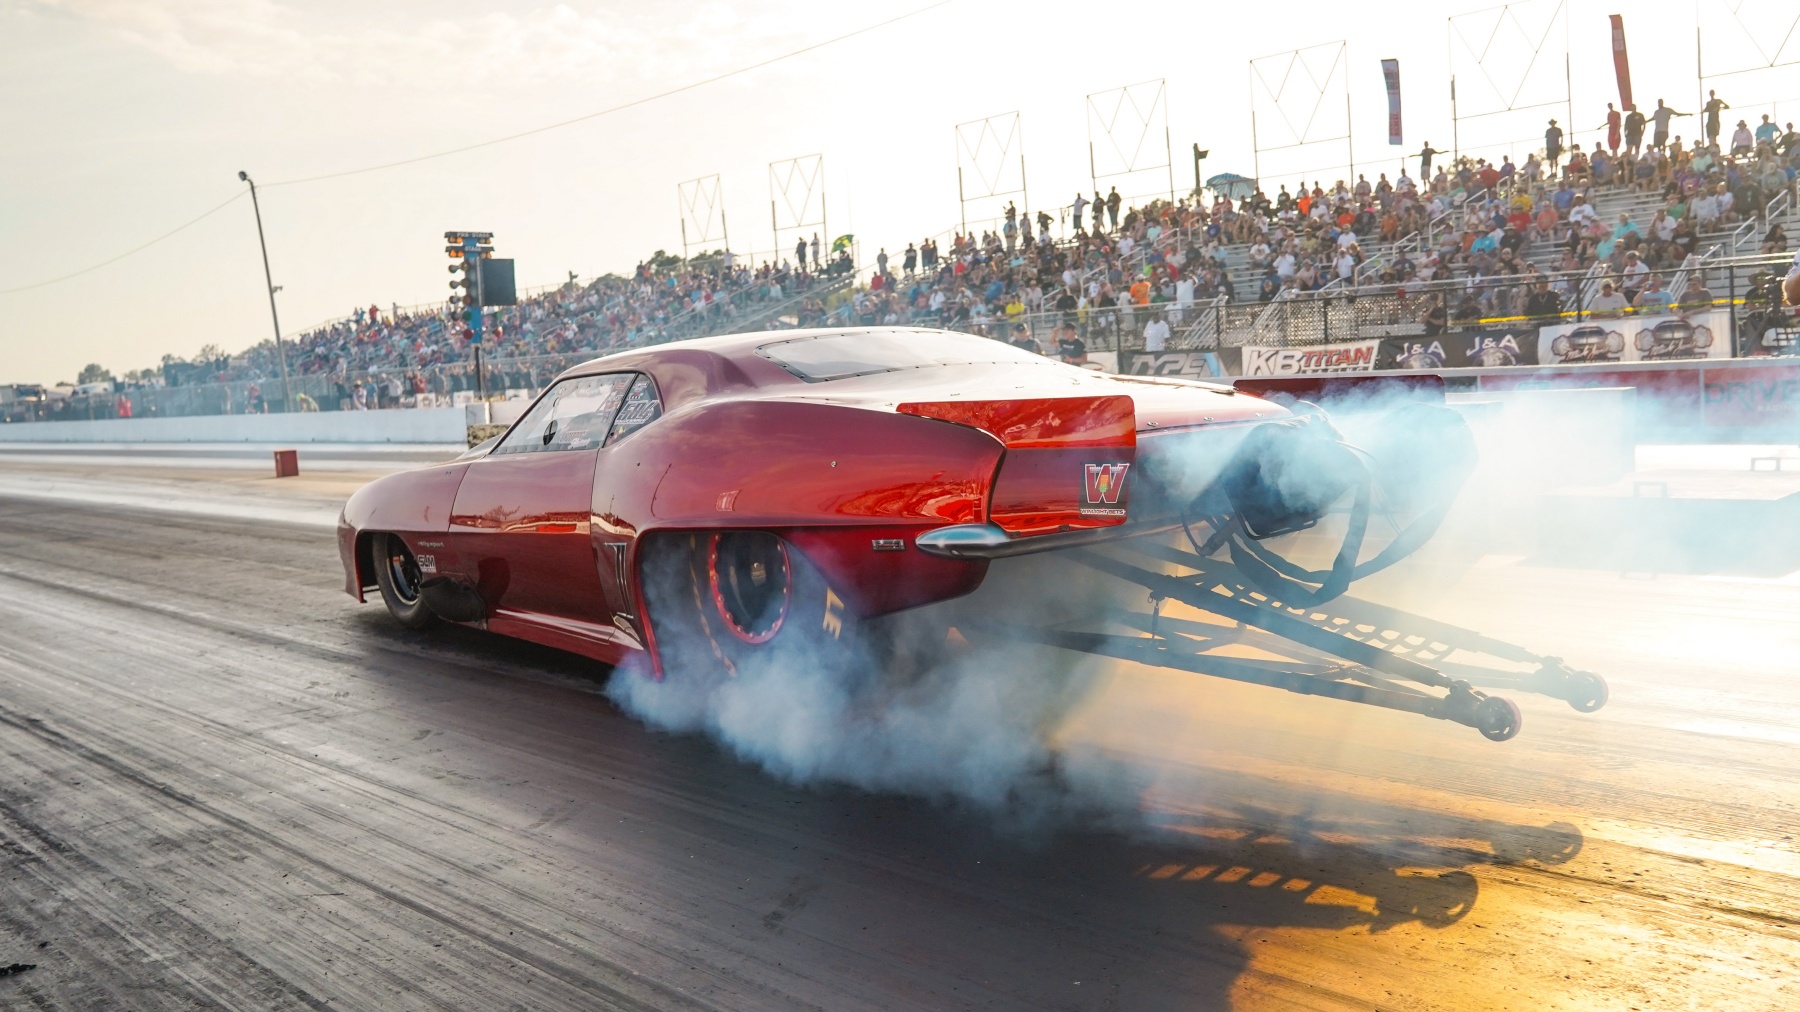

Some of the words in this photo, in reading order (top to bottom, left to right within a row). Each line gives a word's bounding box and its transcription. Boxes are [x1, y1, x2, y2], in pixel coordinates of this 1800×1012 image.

[1396, 341, 1446, 363] J&A
[1466, 334, 1520, 357] J&A
[1130, 353, 1206, 375] TYPE
[1247, 350, 1302, 376] KB
[1302, 346, 1374, 367] TITAN
[1704, 379, 1800, 411] DRIVE
[1084, 463, 1130, 503] W
